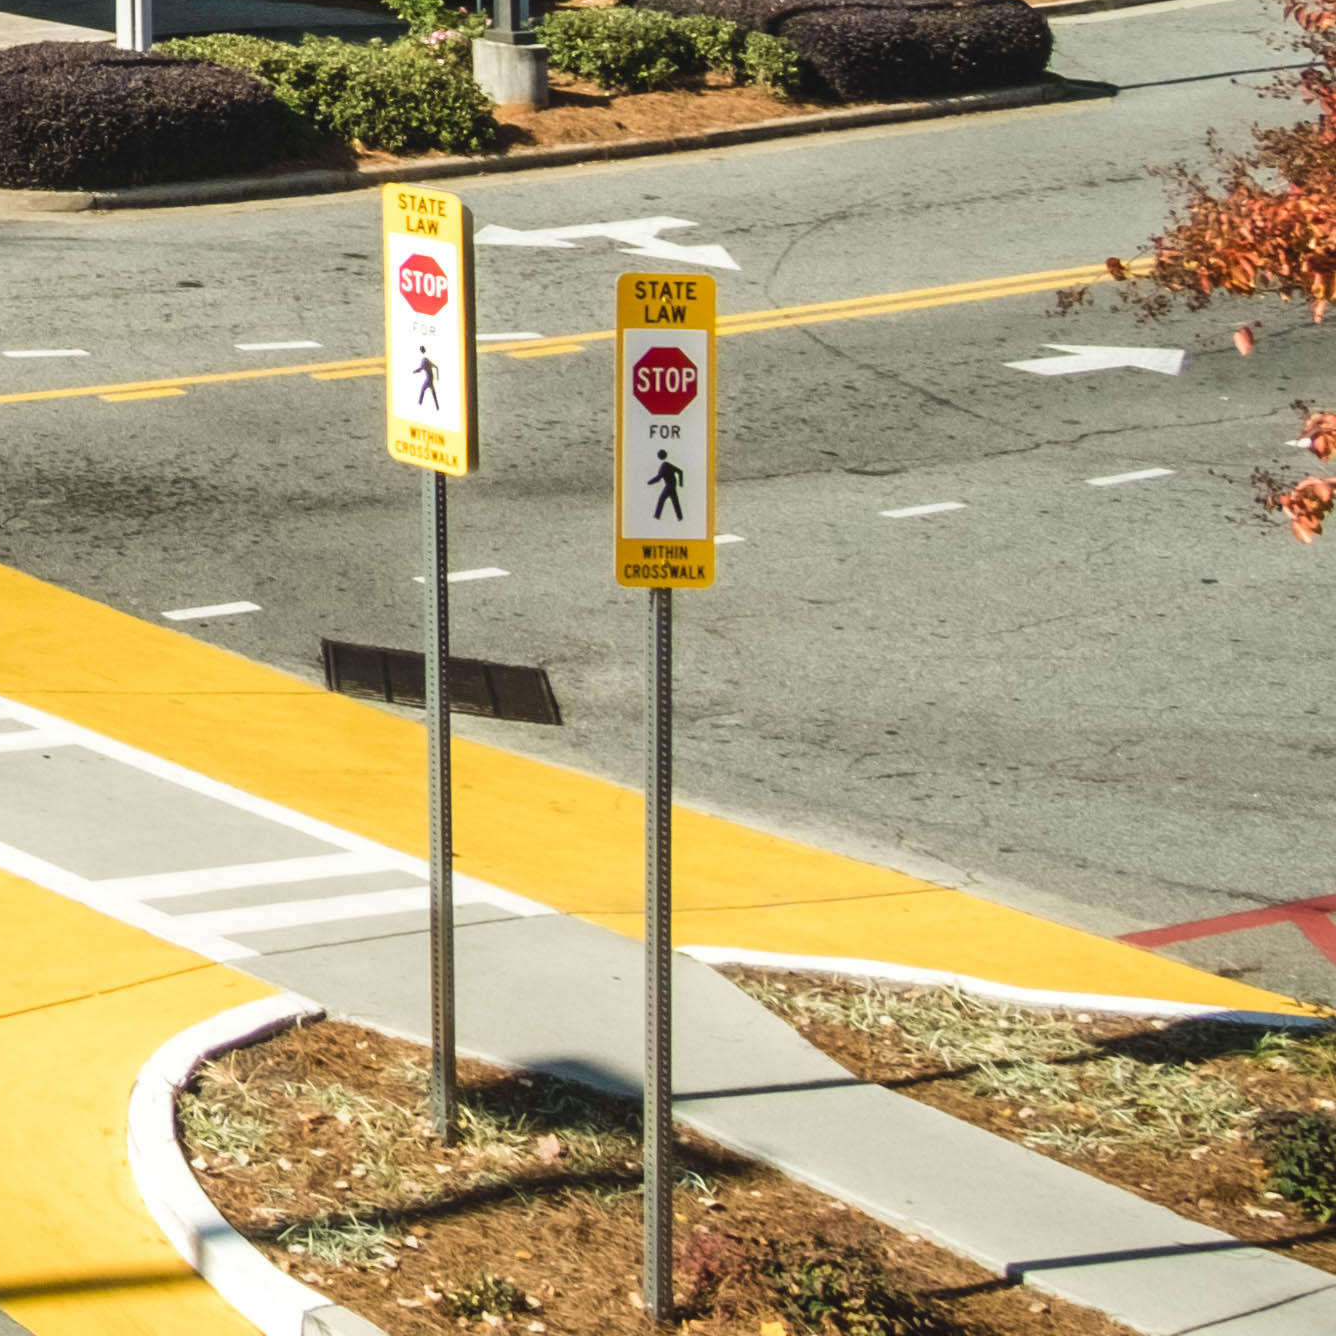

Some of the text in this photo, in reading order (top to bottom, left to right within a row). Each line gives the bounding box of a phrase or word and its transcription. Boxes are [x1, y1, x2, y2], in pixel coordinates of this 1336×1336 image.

[397, 193, 447, 218] STATE
[405, 215, 439, 236] LAW
[401, 267, 449, 298] STOP
[634, 280, 697, 301] STATE
[644, 305, 687, 324] LAW
[412, 321, 437, 336] FOR
[636, 366, 696, 393] STOP
[409, 427, 445, 446] WITHIN
[649, 424, 681, 439] FOR
[394, 439, 459, 469] CROSSWALK
[641, 545, 688, 560] WITHIN
[623, 563, 705, 580] CROSSWALK
